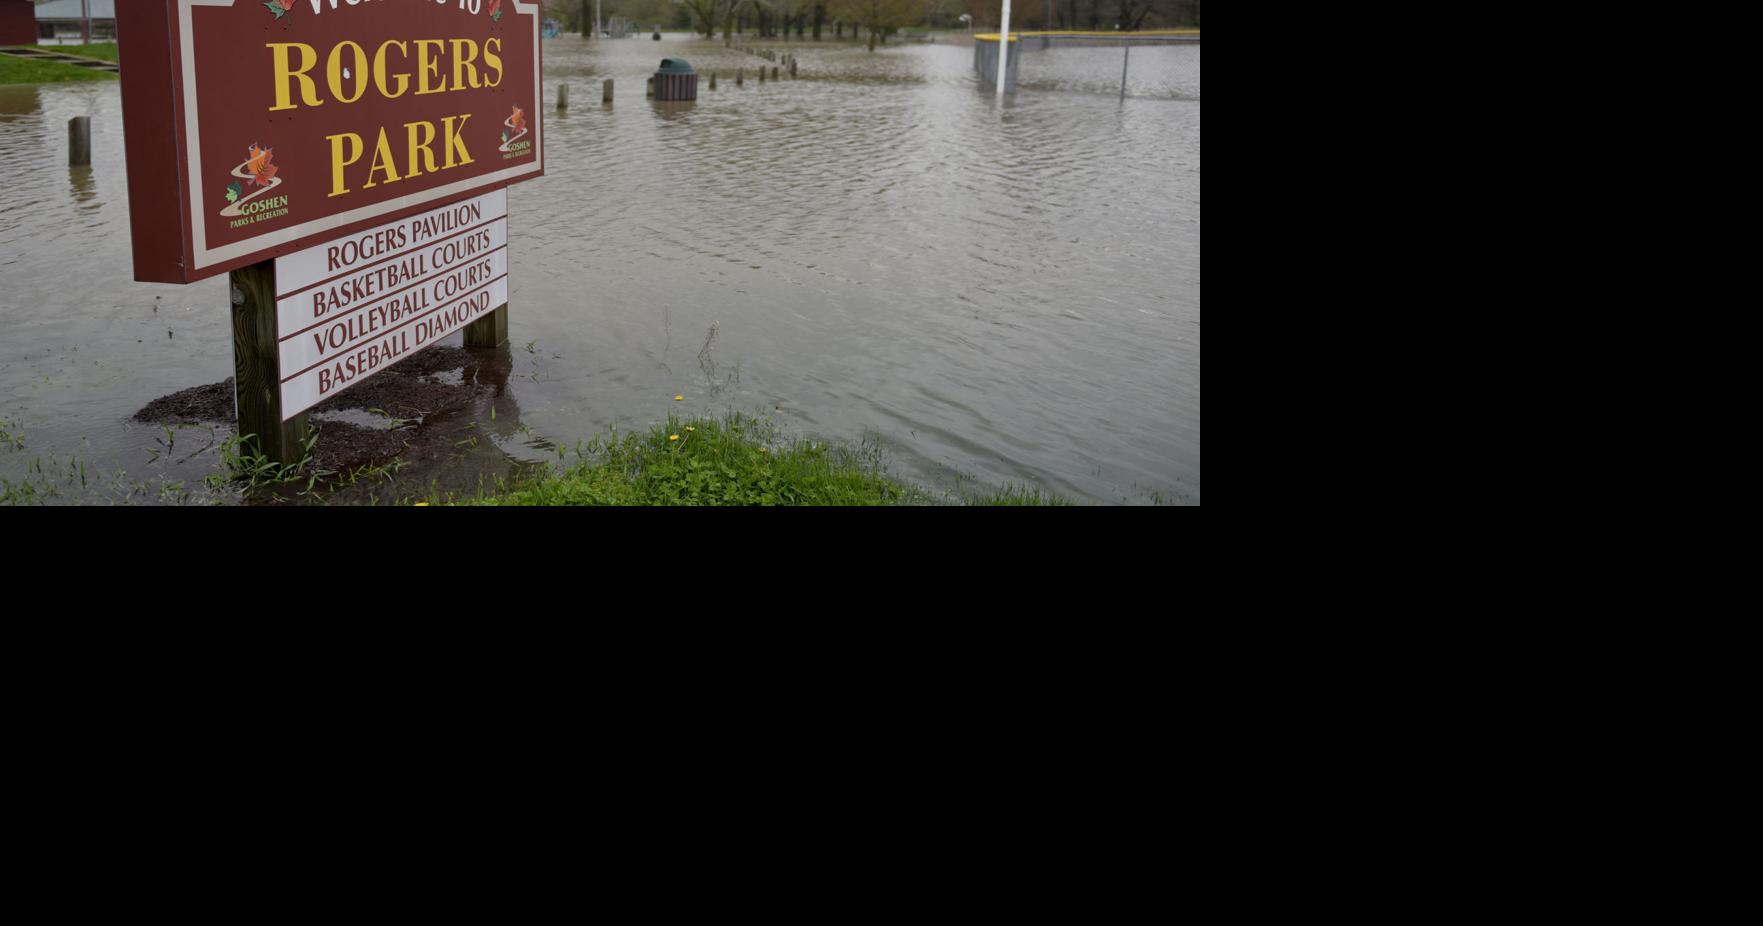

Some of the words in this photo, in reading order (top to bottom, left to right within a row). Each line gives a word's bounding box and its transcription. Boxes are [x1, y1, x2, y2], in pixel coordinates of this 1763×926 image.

[266, 37, 503, 111] ROGERS
[326, 113, 475, 197] PARK
[230, 217, 249, 228] PARKS
[256, 208, 288, 222] RECREATION
[241, 195, 288, 215] GOSHEN
[327, 225, 406, 272] ROGERS
[412, 201, 481, 243] PAVILION
[313, 254, 427, 318] BASKETBALL
[432, 229, 490, 269] COURTS
[314, 288, 429, 355] VOLLEYBALL
[434, 259, 492, 301] COURTS
[318, 330, 410, 395] BASEBALL
[415, 291, 489, 346] DIAMOND
